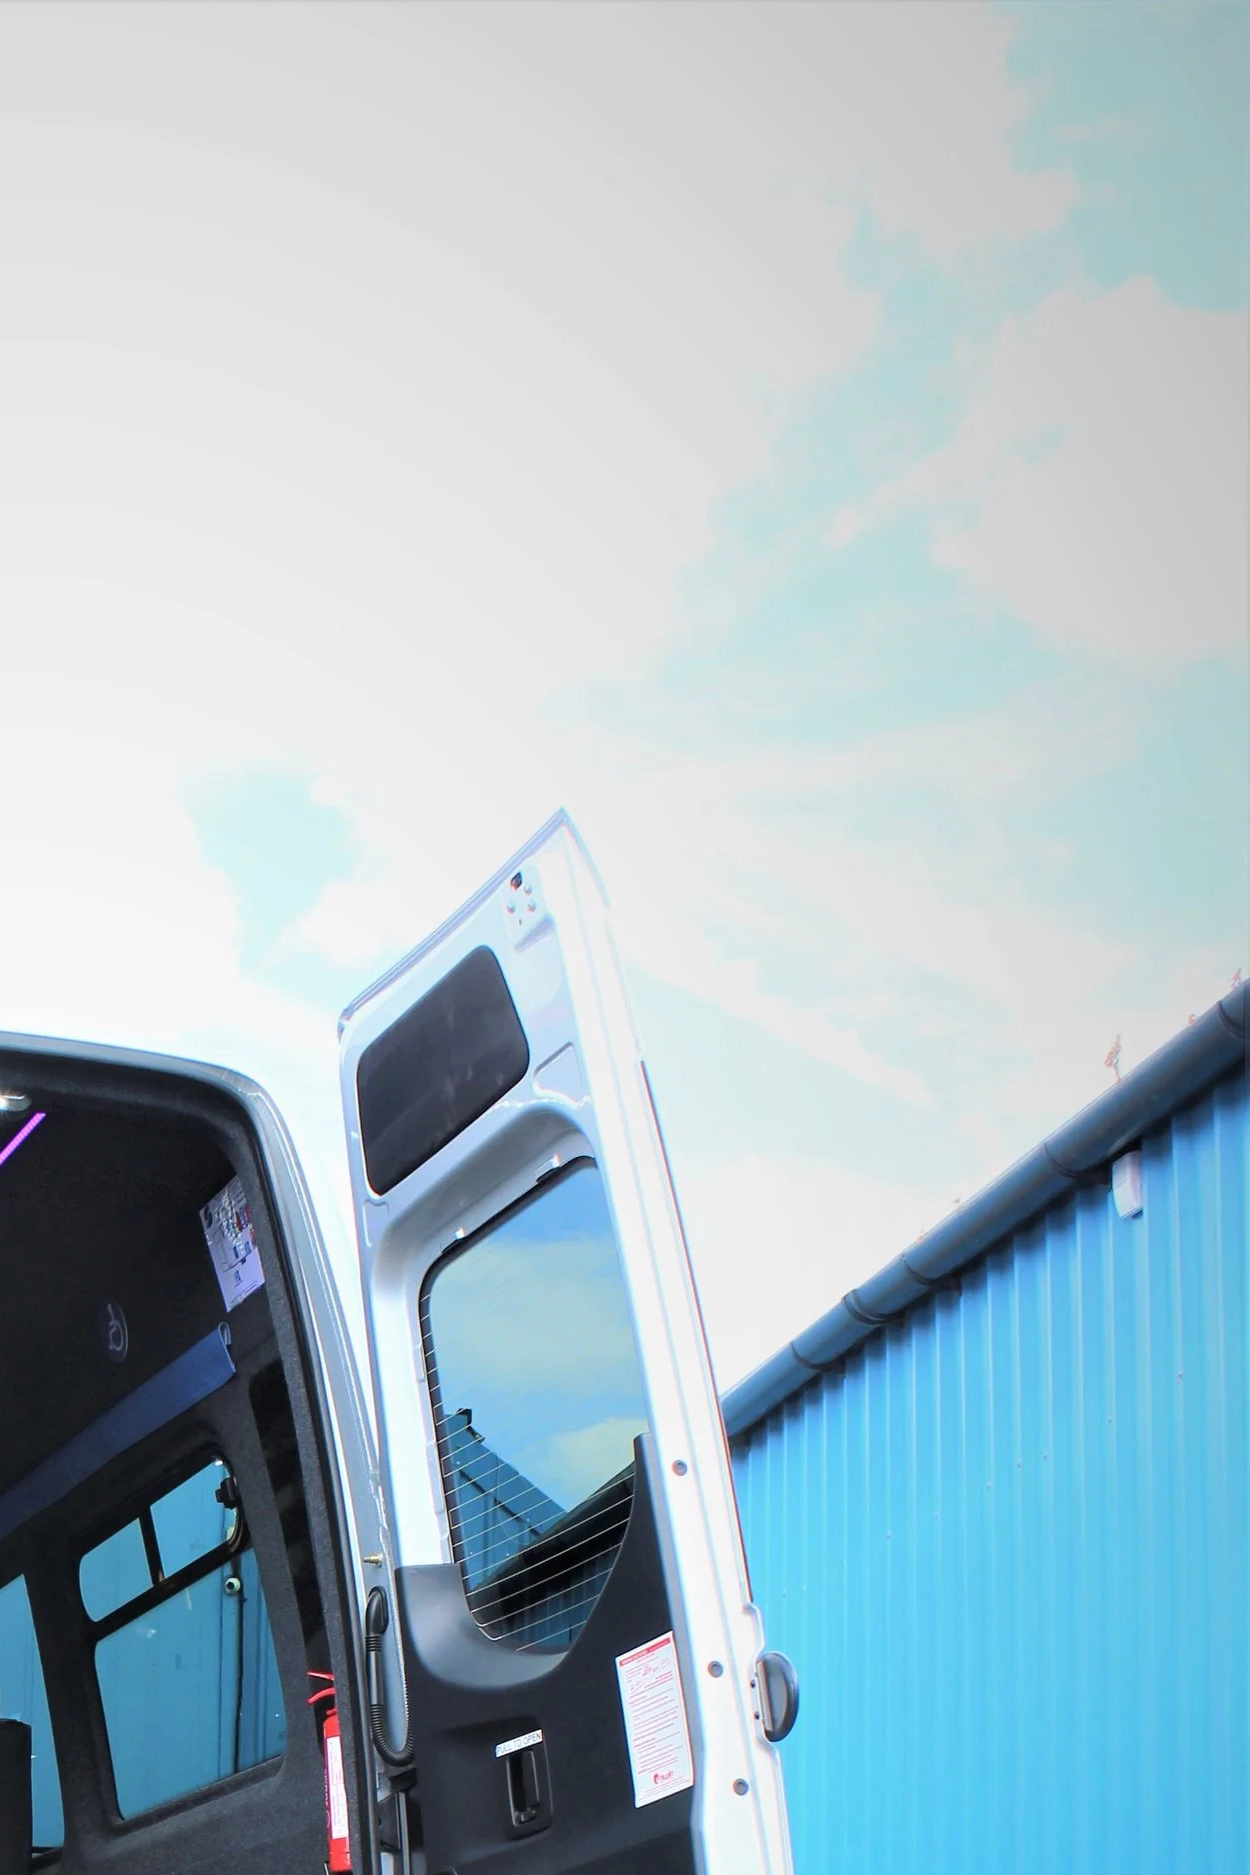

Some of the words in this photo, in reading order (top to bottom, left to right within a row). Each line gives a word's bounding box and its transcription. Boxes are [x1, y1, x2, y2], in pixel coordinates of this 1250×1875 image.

[496, 1743, 512, 1755] PULL
[513, 1738, 522, 1749] TO
[523, 1730, 543, 1746] OPEN
